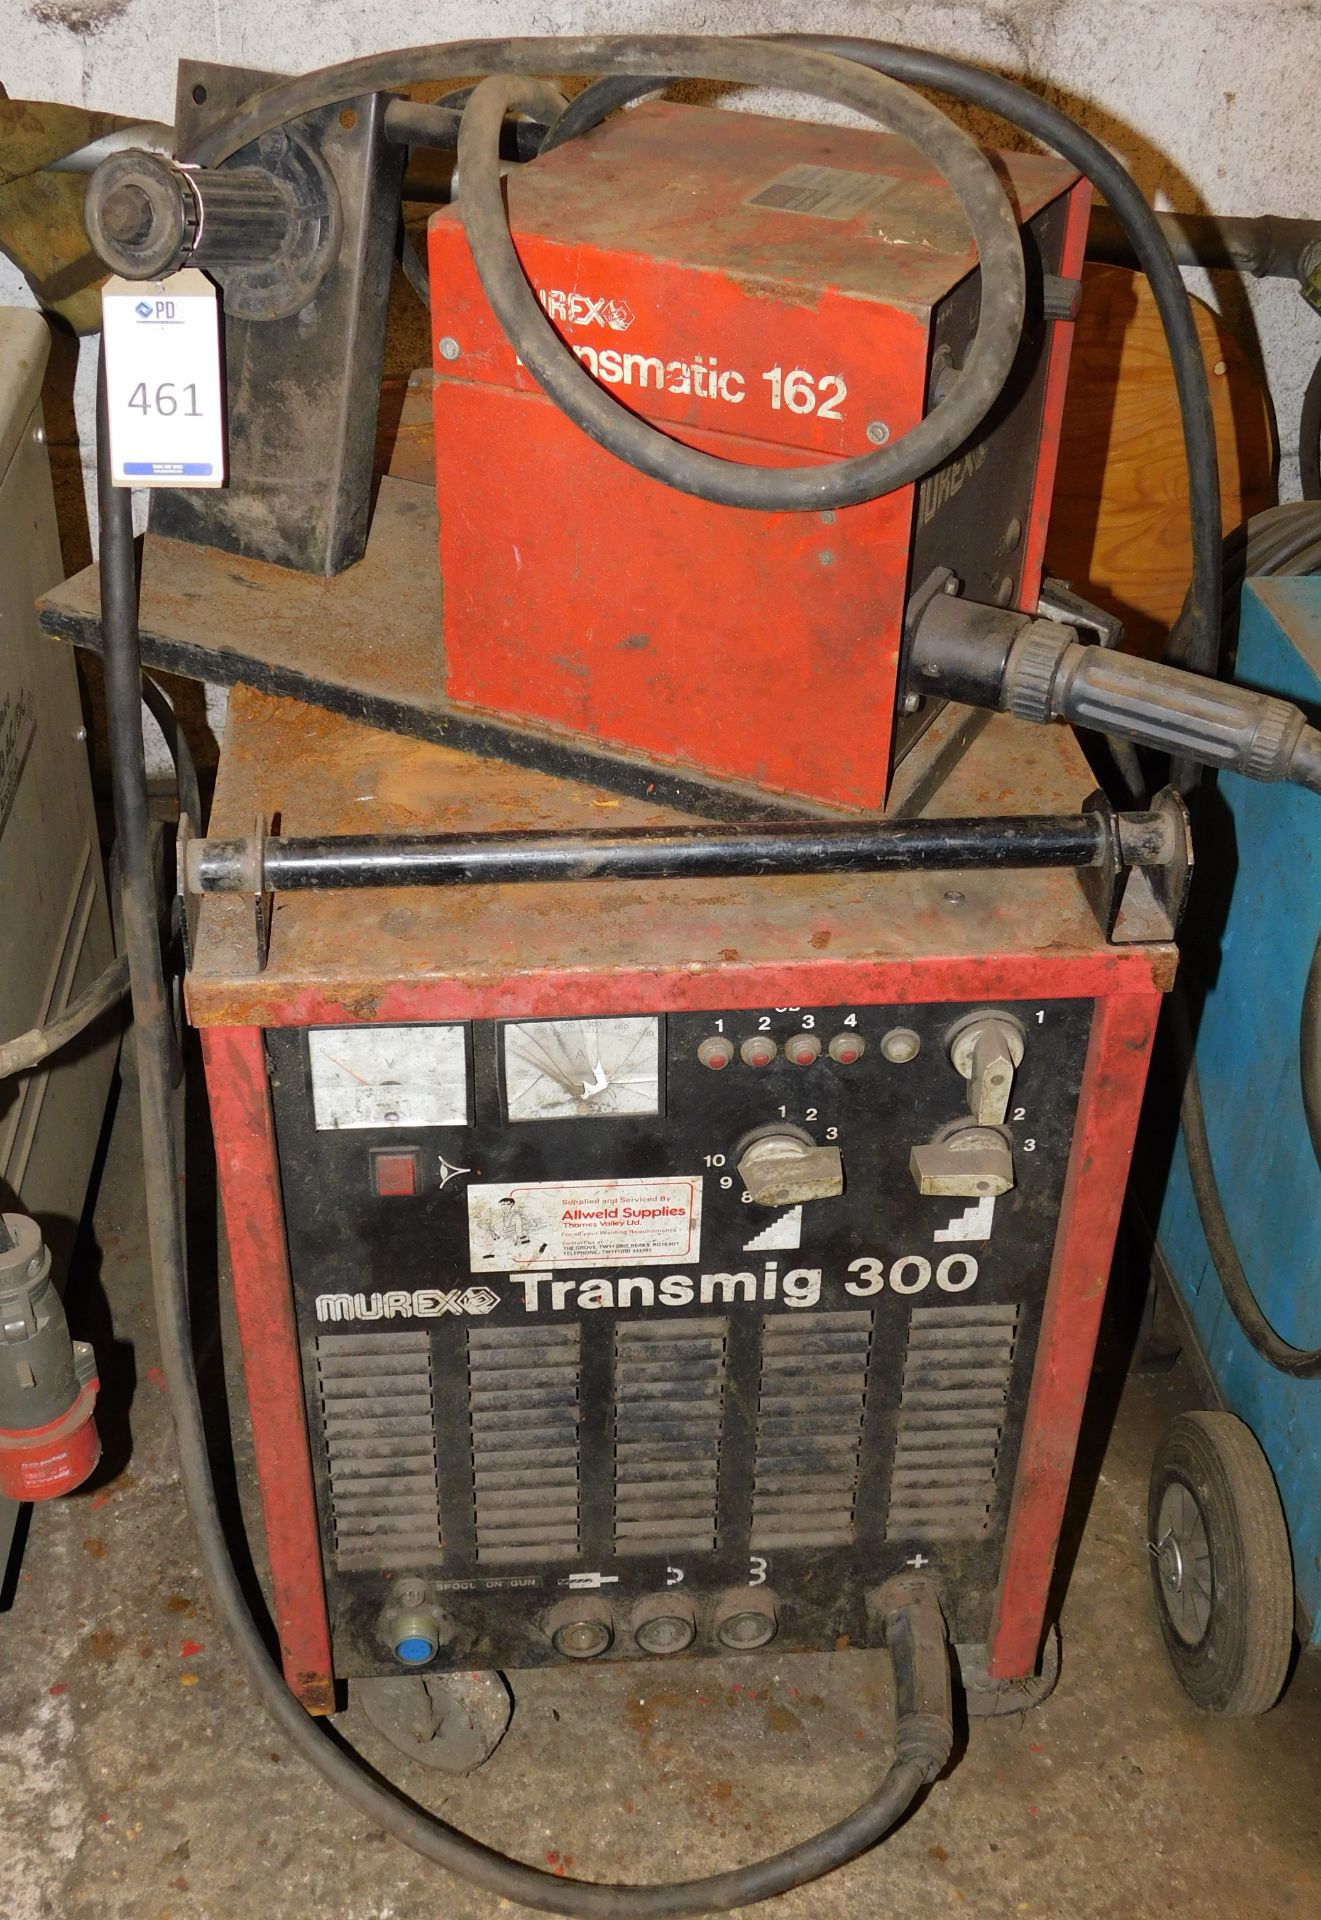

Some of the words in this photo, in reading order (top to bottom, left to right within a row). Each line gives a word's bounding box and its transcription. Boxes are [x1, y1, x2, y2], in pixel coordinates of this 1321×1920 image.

[540, 289, 606, 328] REX
[517, 344, 746, 404] nsmatic
[762, 366, 848, 421] 162
[128, 382, 203, 416] 461
[715, 1019, 724, 1033] 1
[758, 1016, 771, 1030] 2
[802, 1014, 815, 1029] 3
[843, 1013, 858, 1027] 4
[1035, 1010, 1045, 1024] 1
[384, 1057, 396, 1070] V
[778, 1105, 787, 1118] 1
[805, 1108, 818, 1121] 2
[1013, 1107, 1026, 1120] 2
[826, 1127, 839, 1140] 3
[1023, 1138, 1036, 1152] 3
[703, 1154, 727, 1168] 10
[720, 1176, 733, 1189] 9
[562, 1198, 600, 1206] Supplied
[659, 1195, 672, 1203] By
[741, 1191, 753, 1204] 8
[562, 1207, 619, 1221] Allweld
[622, 1205, 687, 1219] Supplies
[563, 1221, 598, 1229] Thames
[599, 1219, 625, 1228] Valley
[510, 1261, 822, 1313] Transmig
[844, 1253, 979, 1296] 300
[315, 1288, 463, 1323] MUREX
[485, 1581, 502, 1589] ON
